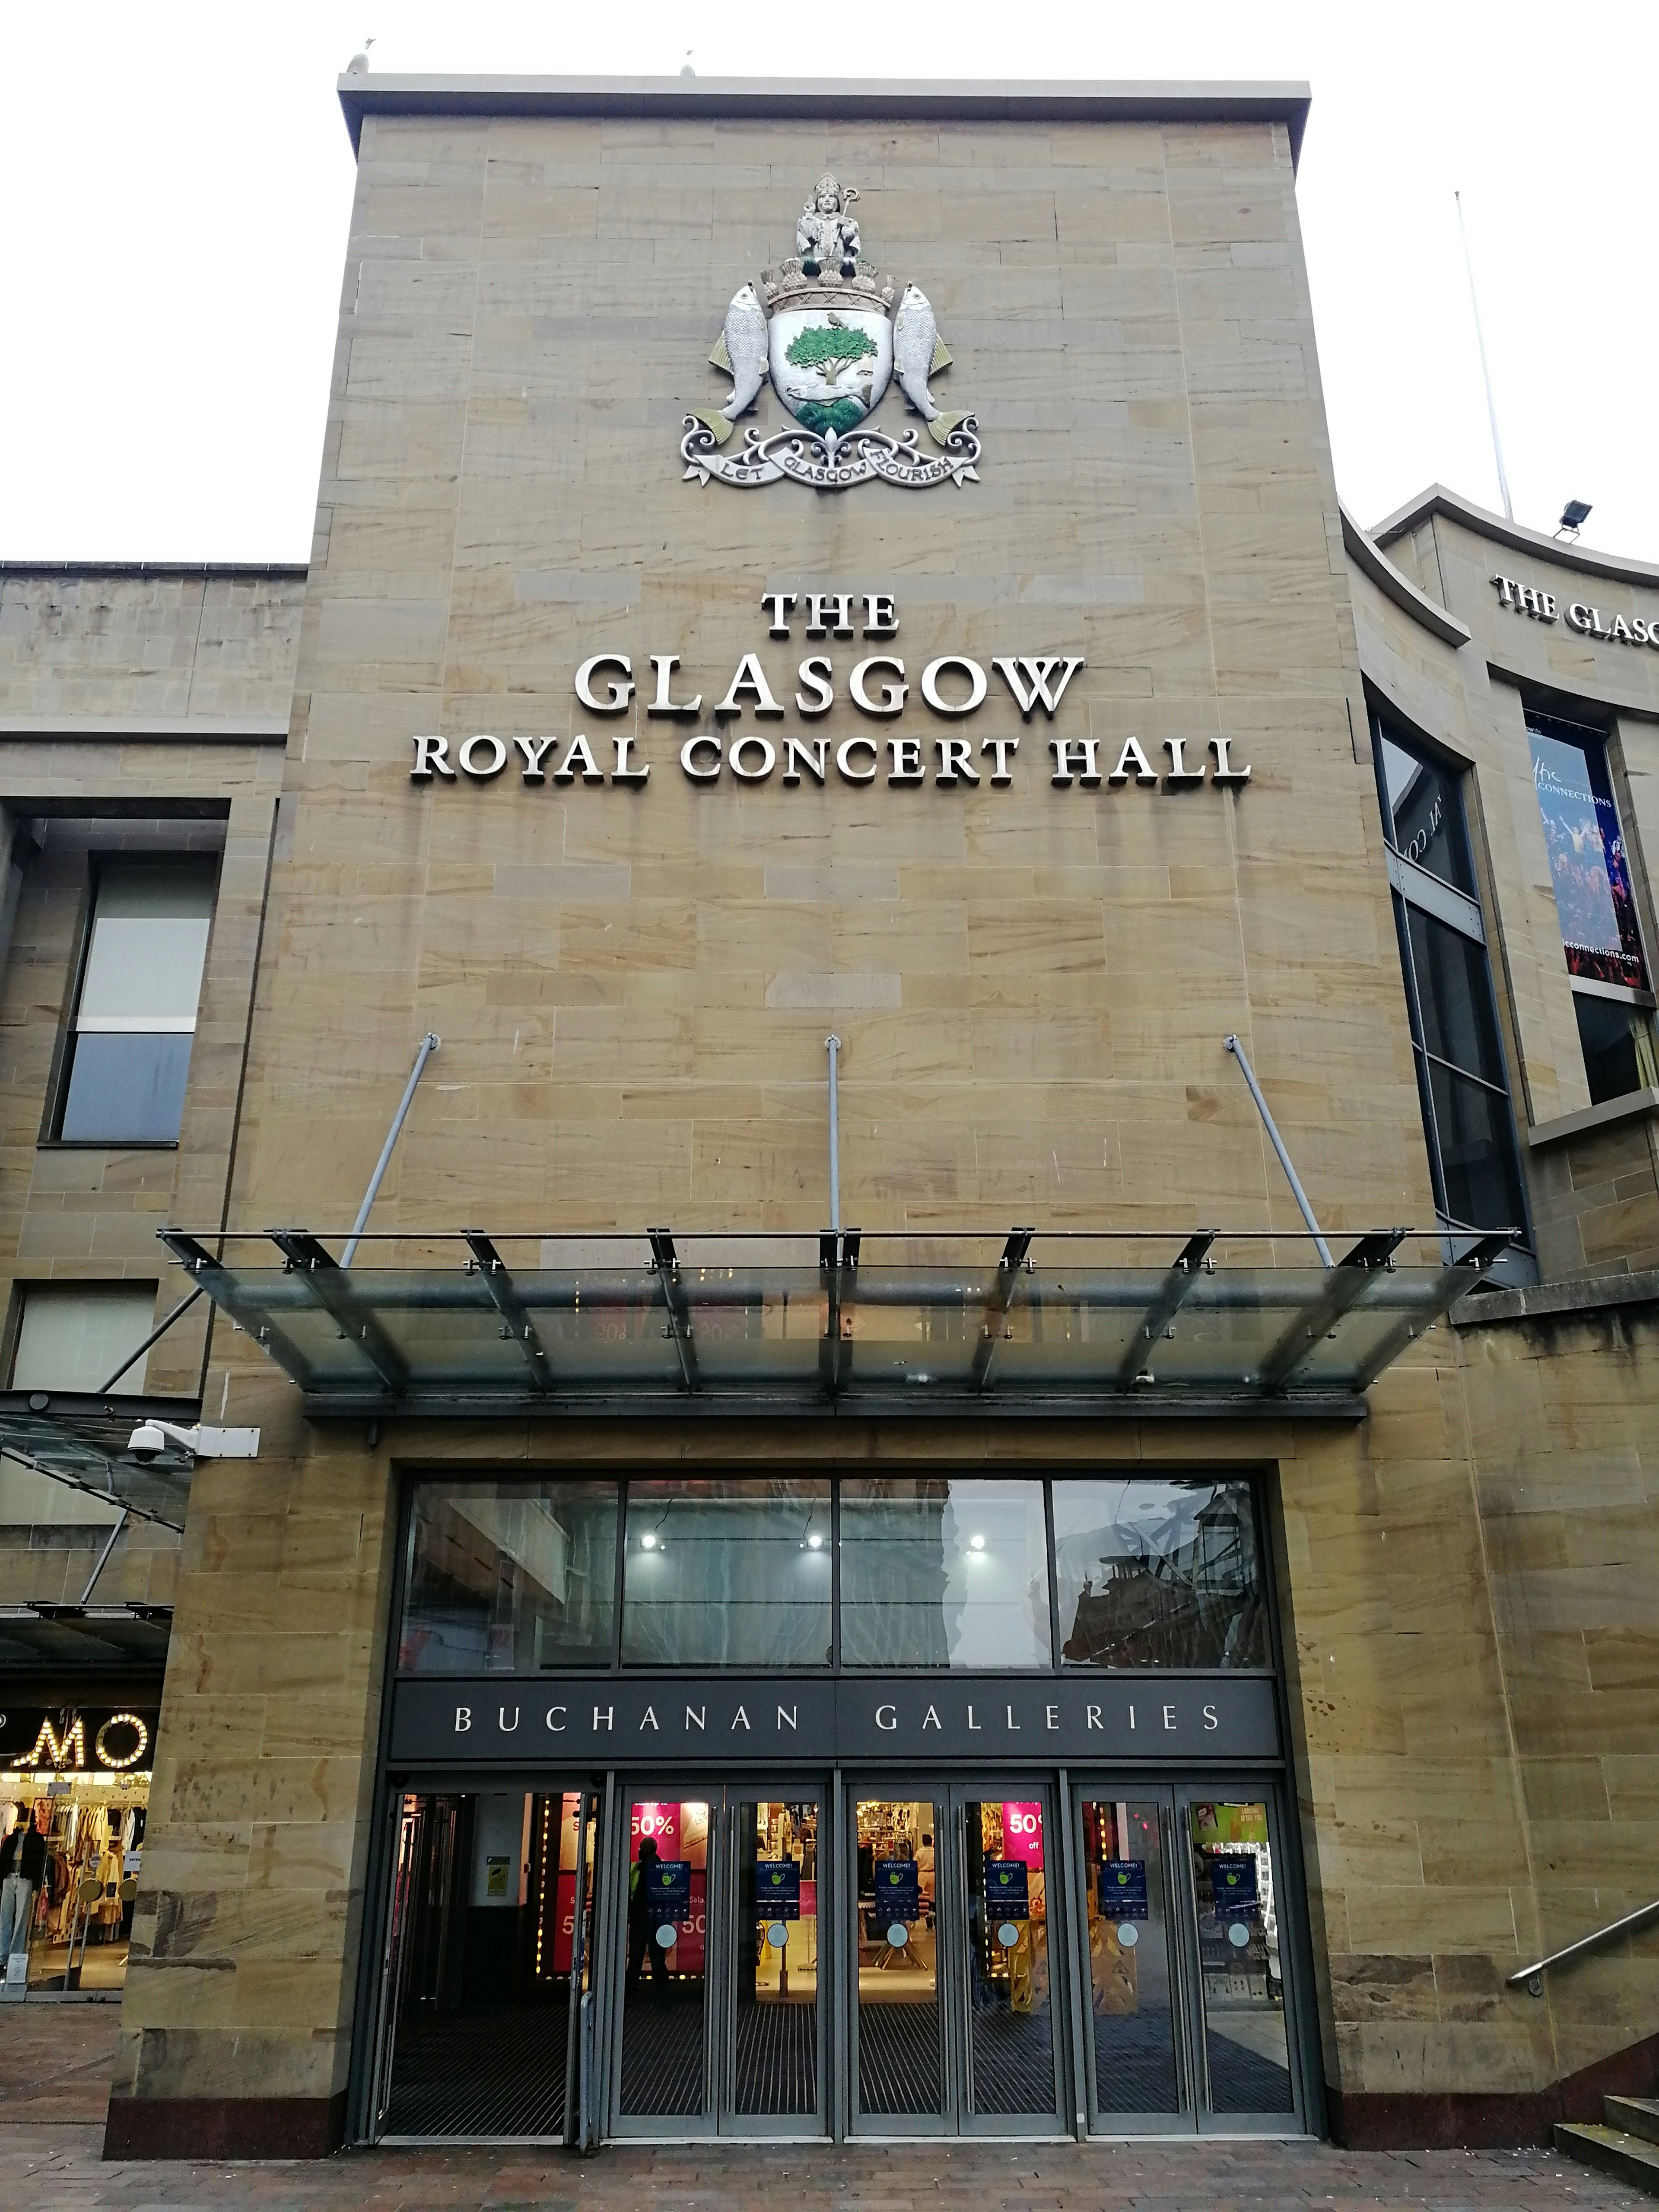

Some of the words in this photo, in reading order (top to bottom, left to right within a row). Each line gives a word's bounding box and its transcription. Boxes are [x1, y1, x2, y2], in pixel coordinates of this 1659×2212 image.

[721, 462, 764, 480] LET
[784, 456, 867, 483] GLASGOW
[870, 449, 954, 480] FLOURISH
[1495, 573, 1560, 619] THE
[763, 593, 899, 639] THE
[575, 654, 1084, 721] GLASGOW
[410, 735, 649, 783] ROYAL
[680, 736, 1020, 785] CONCERT
[1051, 737, 1251, 785] HALL
[1538, 782, 1611, 807] CONNECTIONS
[454, 1706, 797, 1732] BUCHANAN
[874, 1704, 1218, 1730] GALLERIES
[631, 1815, 674, 1835] 50%
[1010, 1814, 1042, 1834] 50
